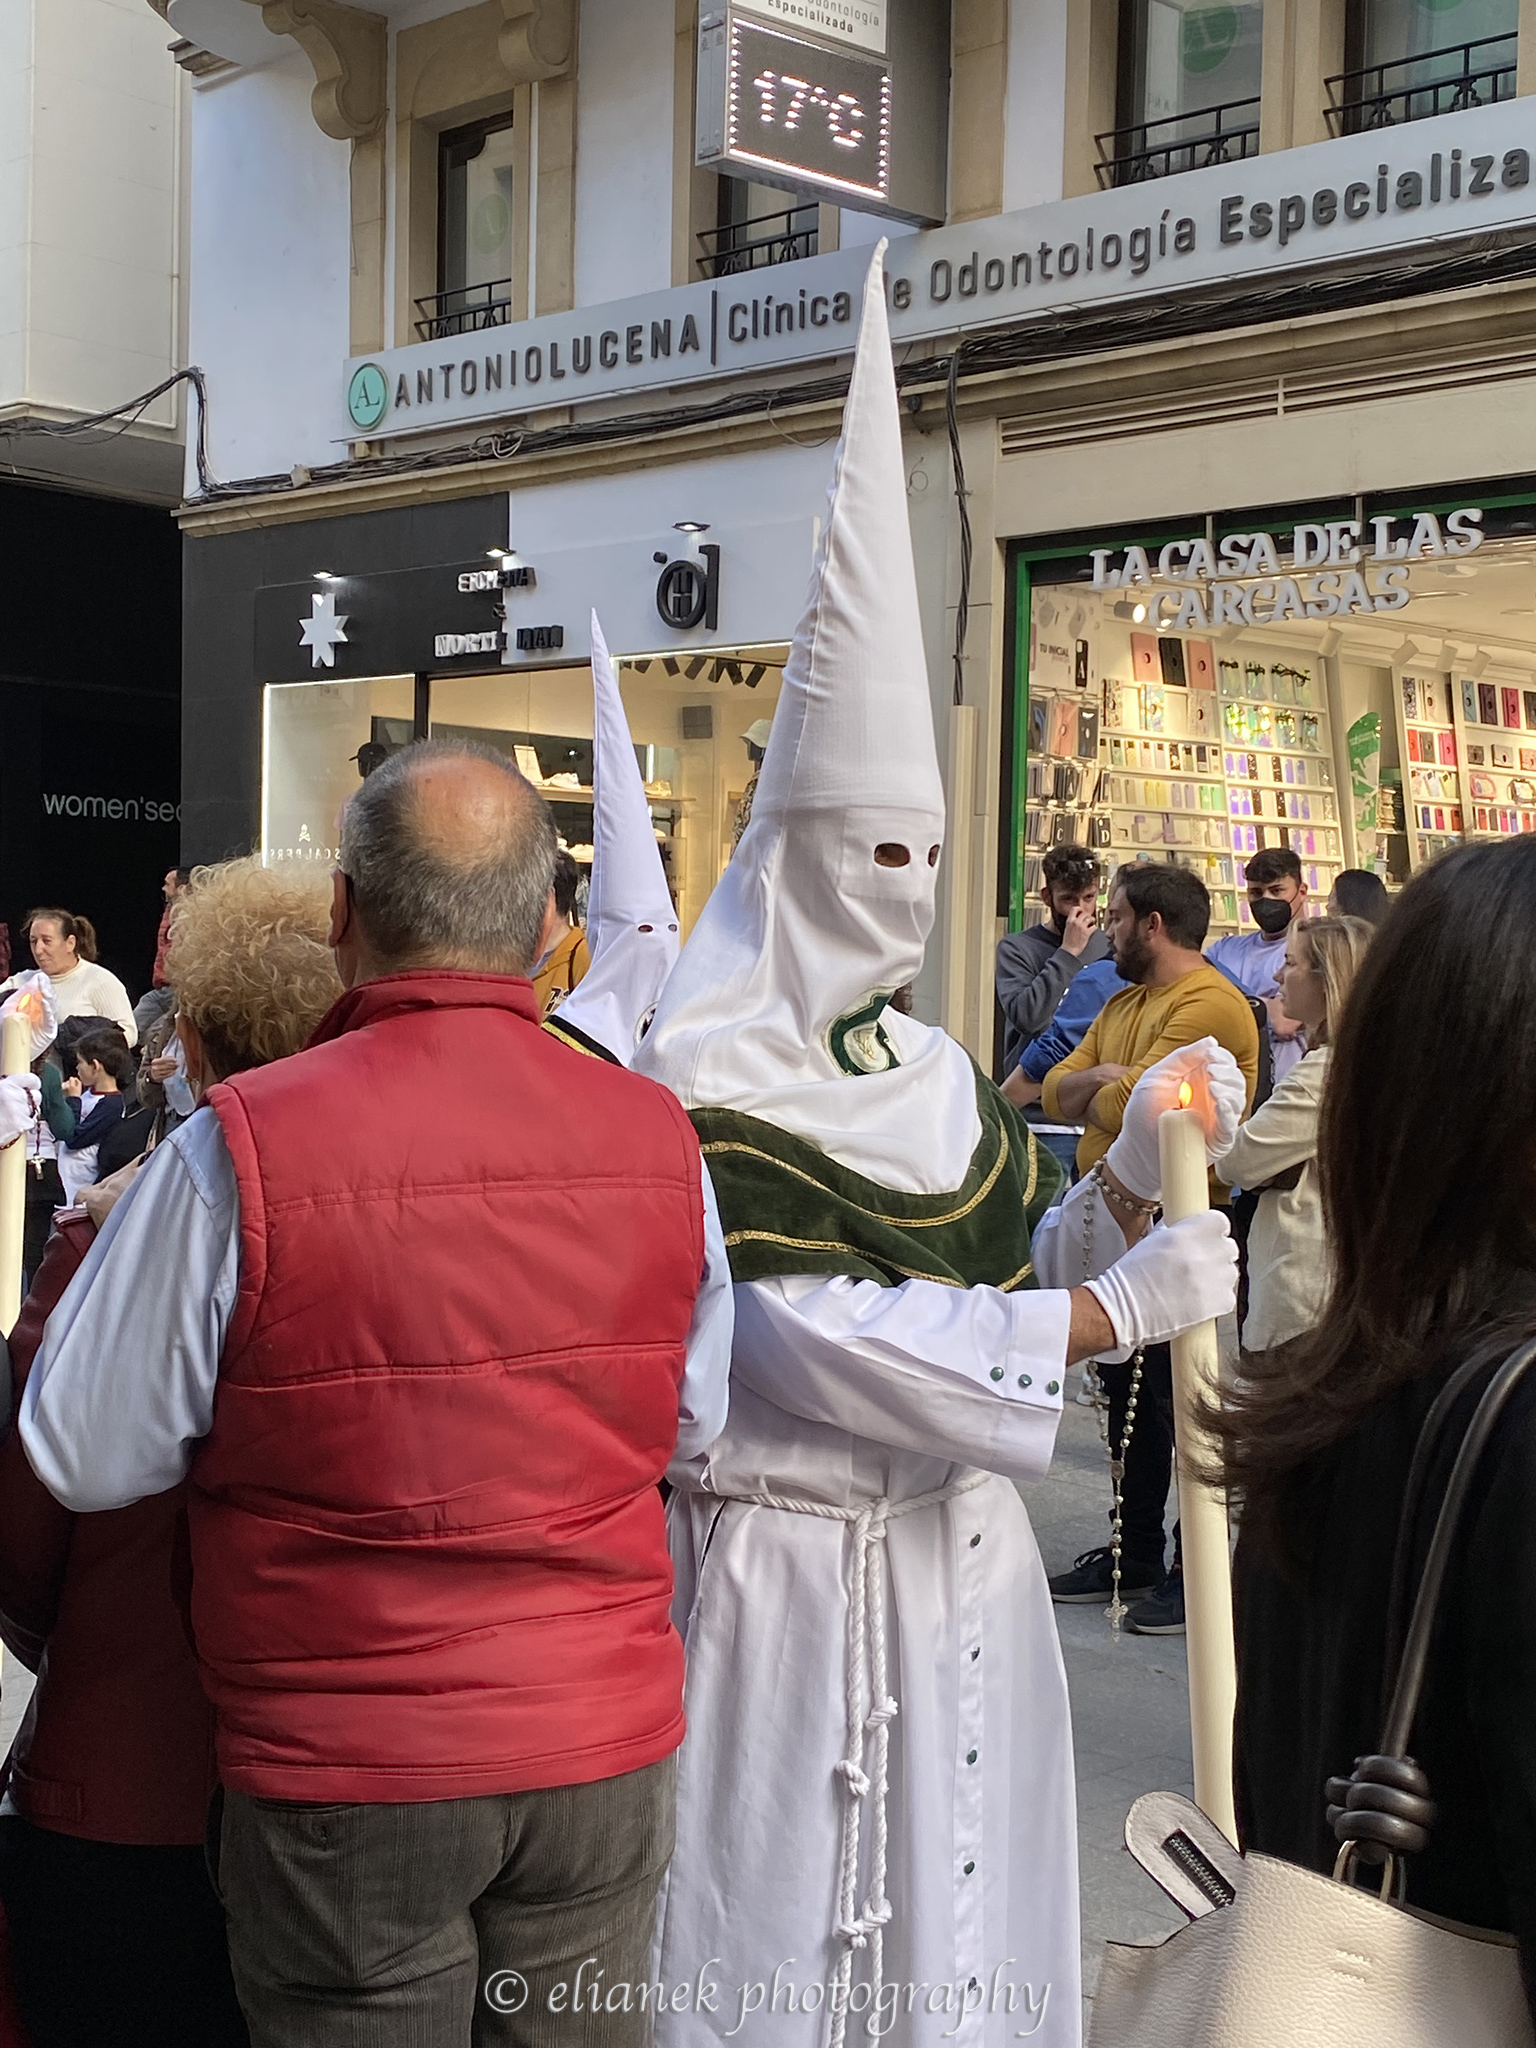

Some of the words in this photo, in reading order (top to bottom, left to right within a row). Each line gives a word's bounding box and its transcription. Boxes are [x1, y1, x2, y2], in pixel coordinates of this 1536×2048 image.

[728, 291, 850, 343] Clínica
[930, 208, 1197, 301] Odontología
[1219, 148, 1530, 245] Especializa
[1088, 548, 1153, 590] LA
[1158, 532, 1282, 581] CASA
[1293, 520, 1362, 567] DE
[1368, 508, 1485, 561] LAS
[1150, 566, 1411, 629] CARCASAS
